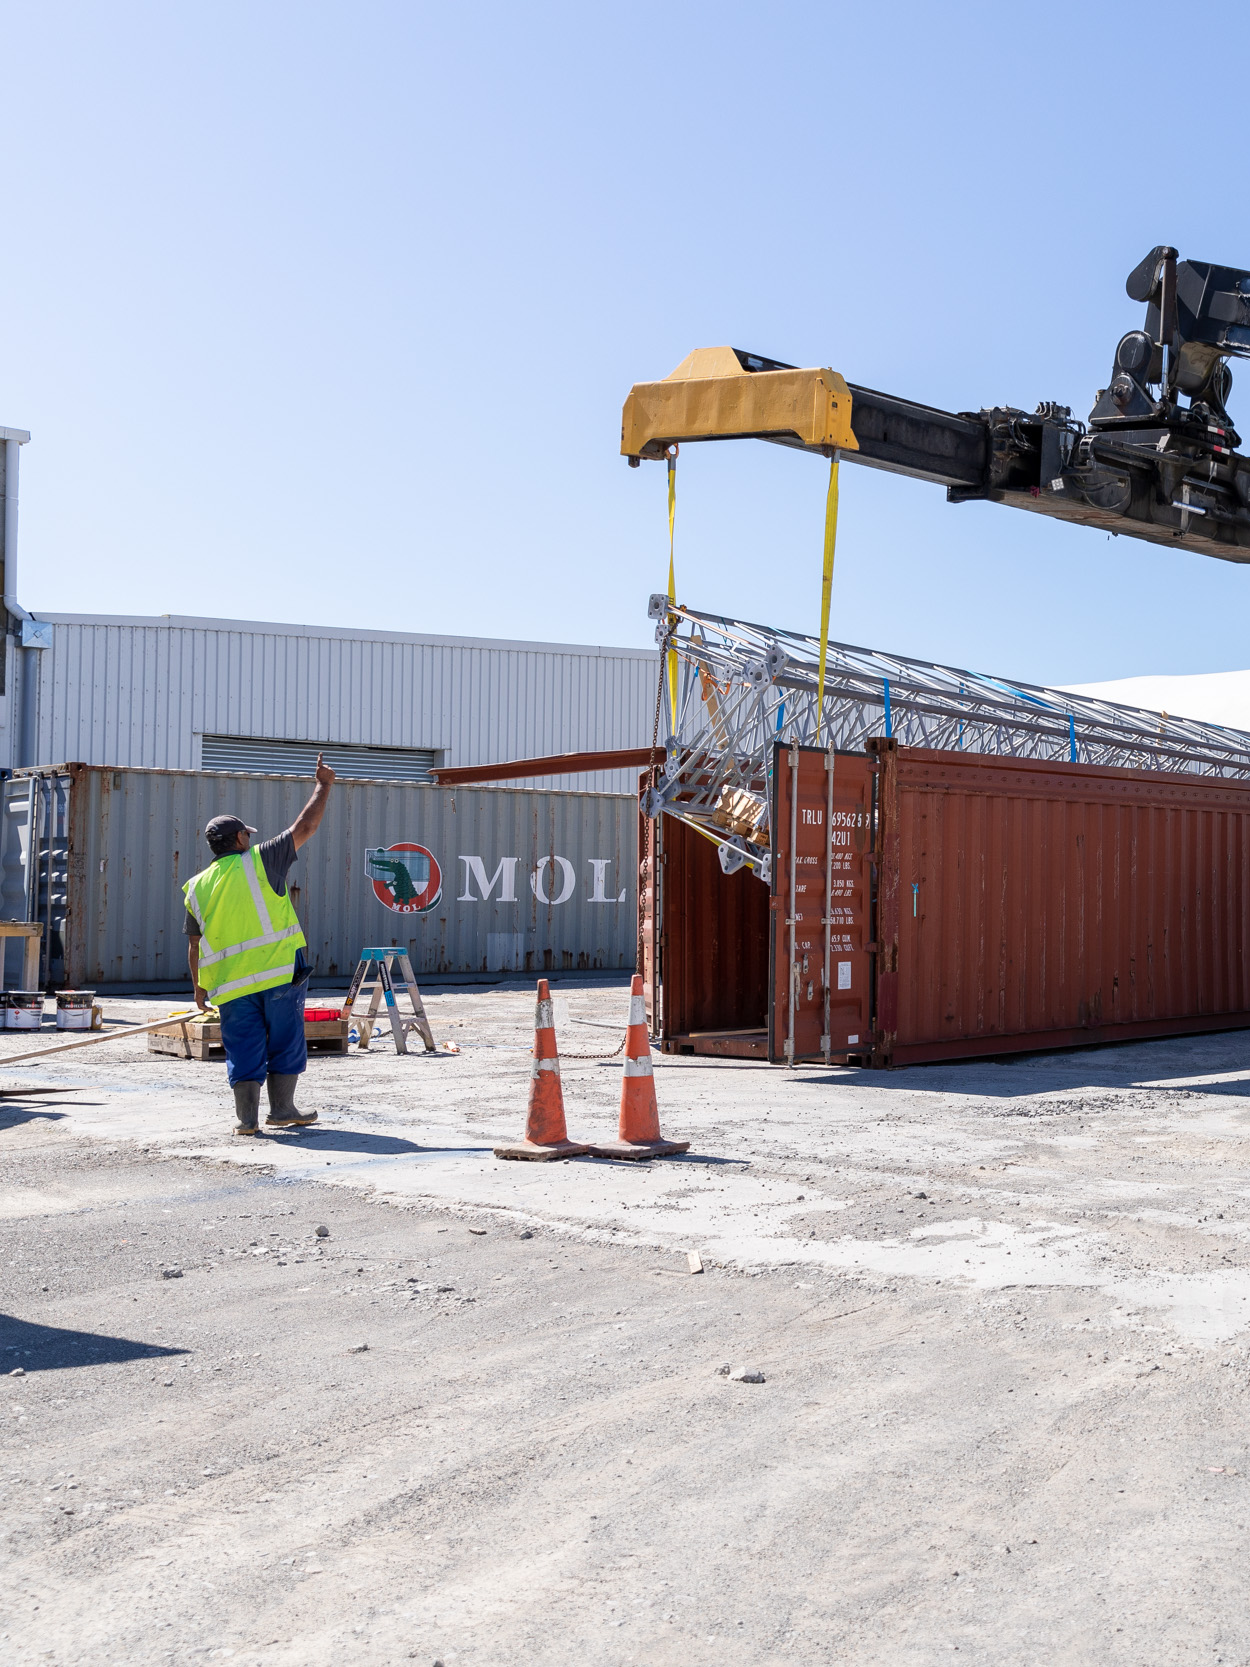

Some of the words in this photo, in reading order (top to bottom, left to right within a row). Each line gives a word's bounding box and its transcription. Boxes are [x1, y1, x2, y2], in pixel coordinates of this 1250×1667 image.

[802, 809, 822, 824] TRLU
[832, 831, 850, 846] 42U1
[456, 855, 626, 905] MOL
[392, 902, 420, 912] MOL
